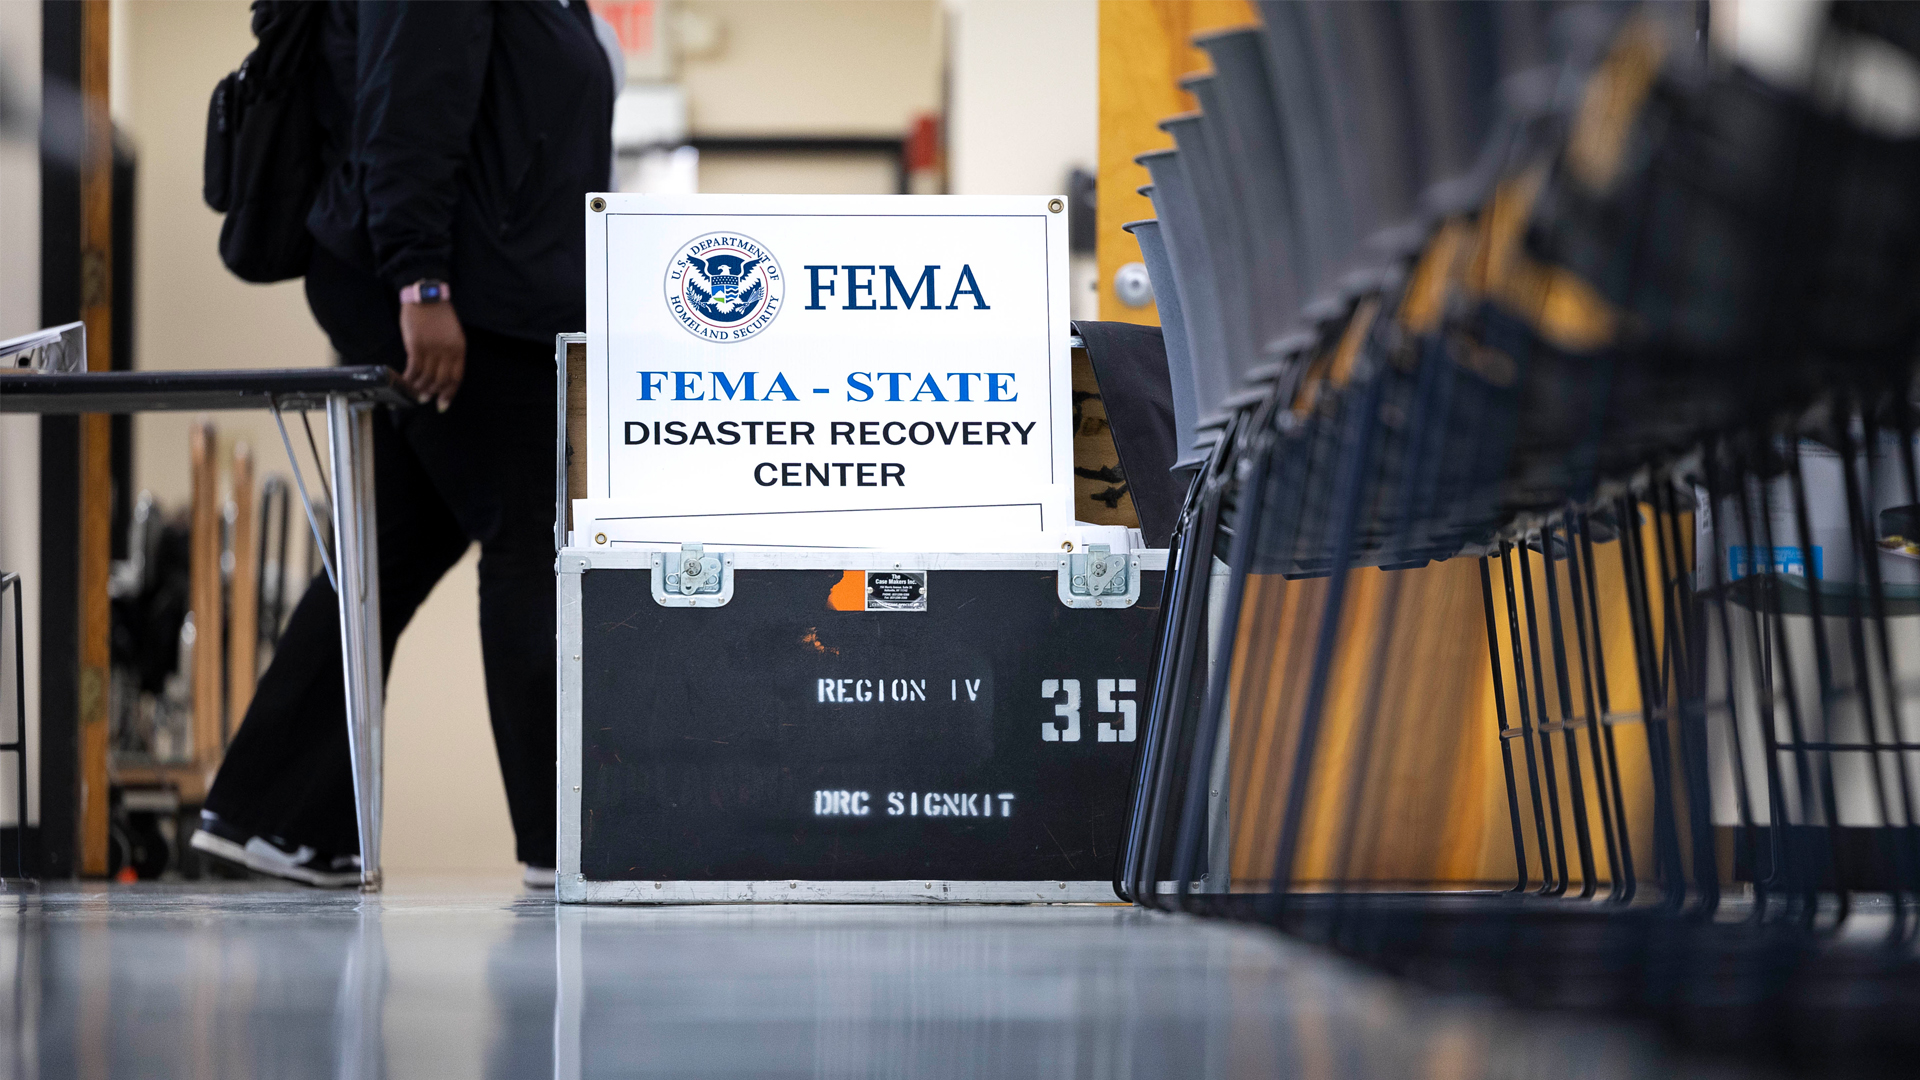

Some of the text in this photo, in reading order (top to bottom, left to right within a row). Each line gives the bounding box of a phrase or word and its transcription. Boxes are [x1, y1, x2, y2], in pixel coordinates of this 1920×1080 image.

[671, 236, 780, 281] U.S. DEPARTMENT OF
[803, 263, 991, 311] FEMA
[670, 295, 780, 340] HOMELAND SECURITY
[636, 371, 801, 402] FEMA
[846, 371, 1019, 403] STATE
[624, 420, 1037, 446] DISASTER RECOVERY
[753, 462, 906, 487] CENTER
[817, 678, 981, 703] REGION IV
[1041, 678, 1137, 743] 35
[814, 790, 1015, 817] DRC SIGNKIT
